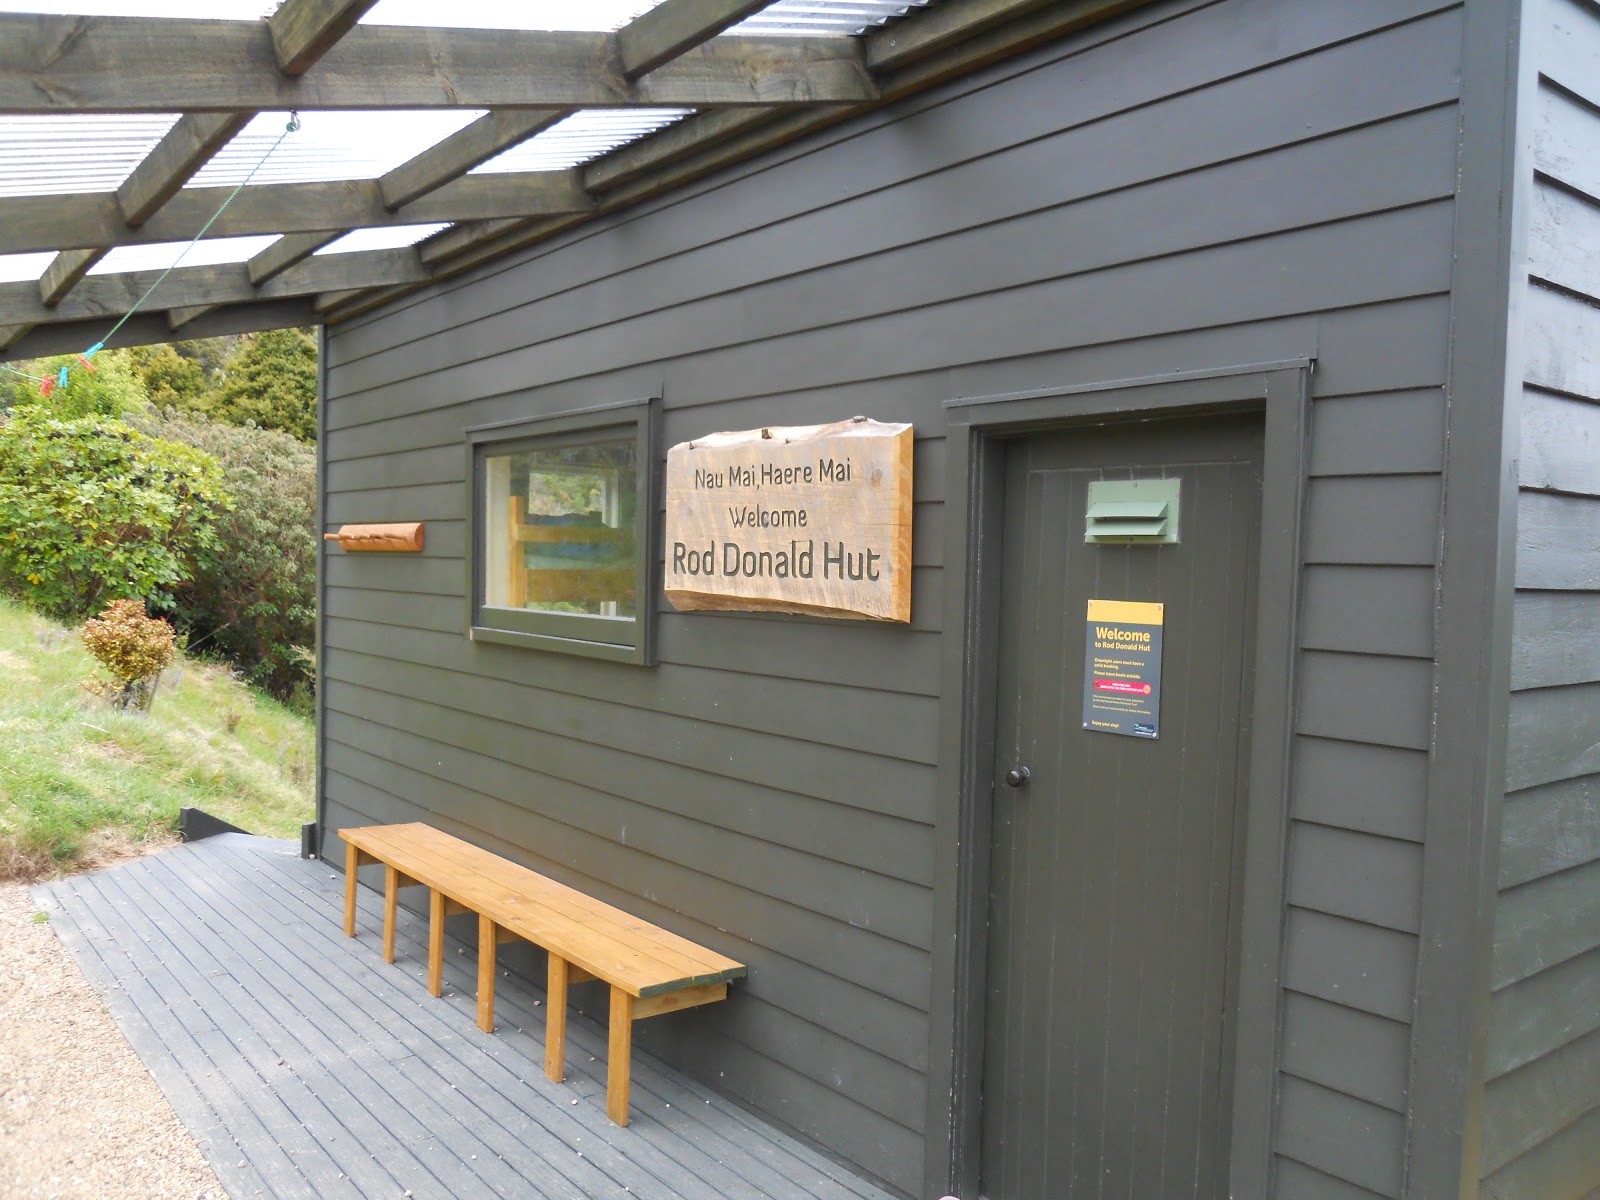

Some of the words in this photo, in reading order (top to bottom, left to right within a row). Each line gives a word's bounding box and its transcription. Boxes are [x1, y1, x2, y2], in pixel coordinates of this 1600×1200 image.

[695, 469, 723, 489] Nau
[761, 463, 813, 485] Haere
[819, 457, 851, 483] Mai
[728, 504, 808, 528] Welcome
[673, 540, 715, 576] Rod
[722, 539, 814, 579] Donald
[823, 541, 881, 582] Hut
[1096, 626, 1151, 643] Welcome
[1116, 642, 1137, 651] Donald
[1138, 644, 1151, 652] Hut
